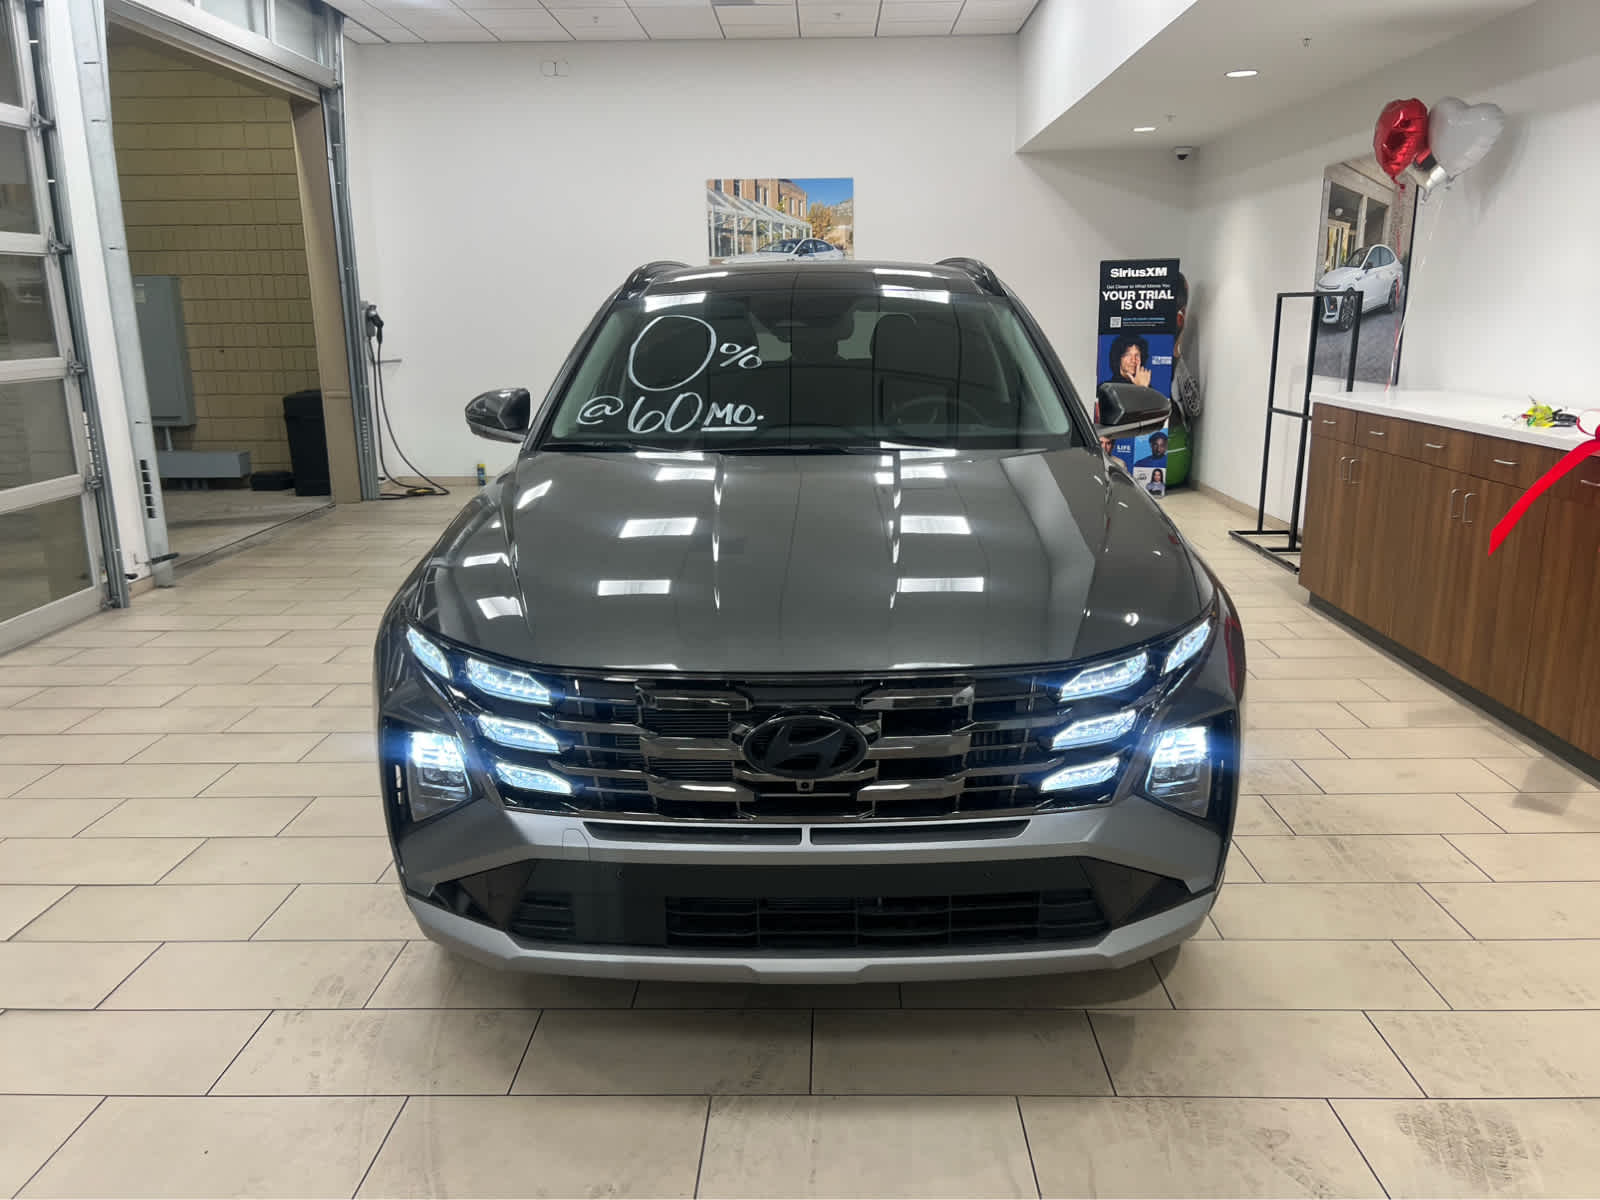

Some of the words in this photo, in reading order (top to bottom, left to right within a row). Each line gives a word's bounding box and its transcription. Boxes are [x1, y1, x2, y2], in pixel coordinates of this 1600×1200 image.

[1110, 267, 1168, 278] SiriusXM
[1102, 290, 1136, 301] YOUR
[1138, 289, 1175, 300] TRIAL
[1121, 300, 1133, 310] IS
[1135, 300, 1154, 310] ON
